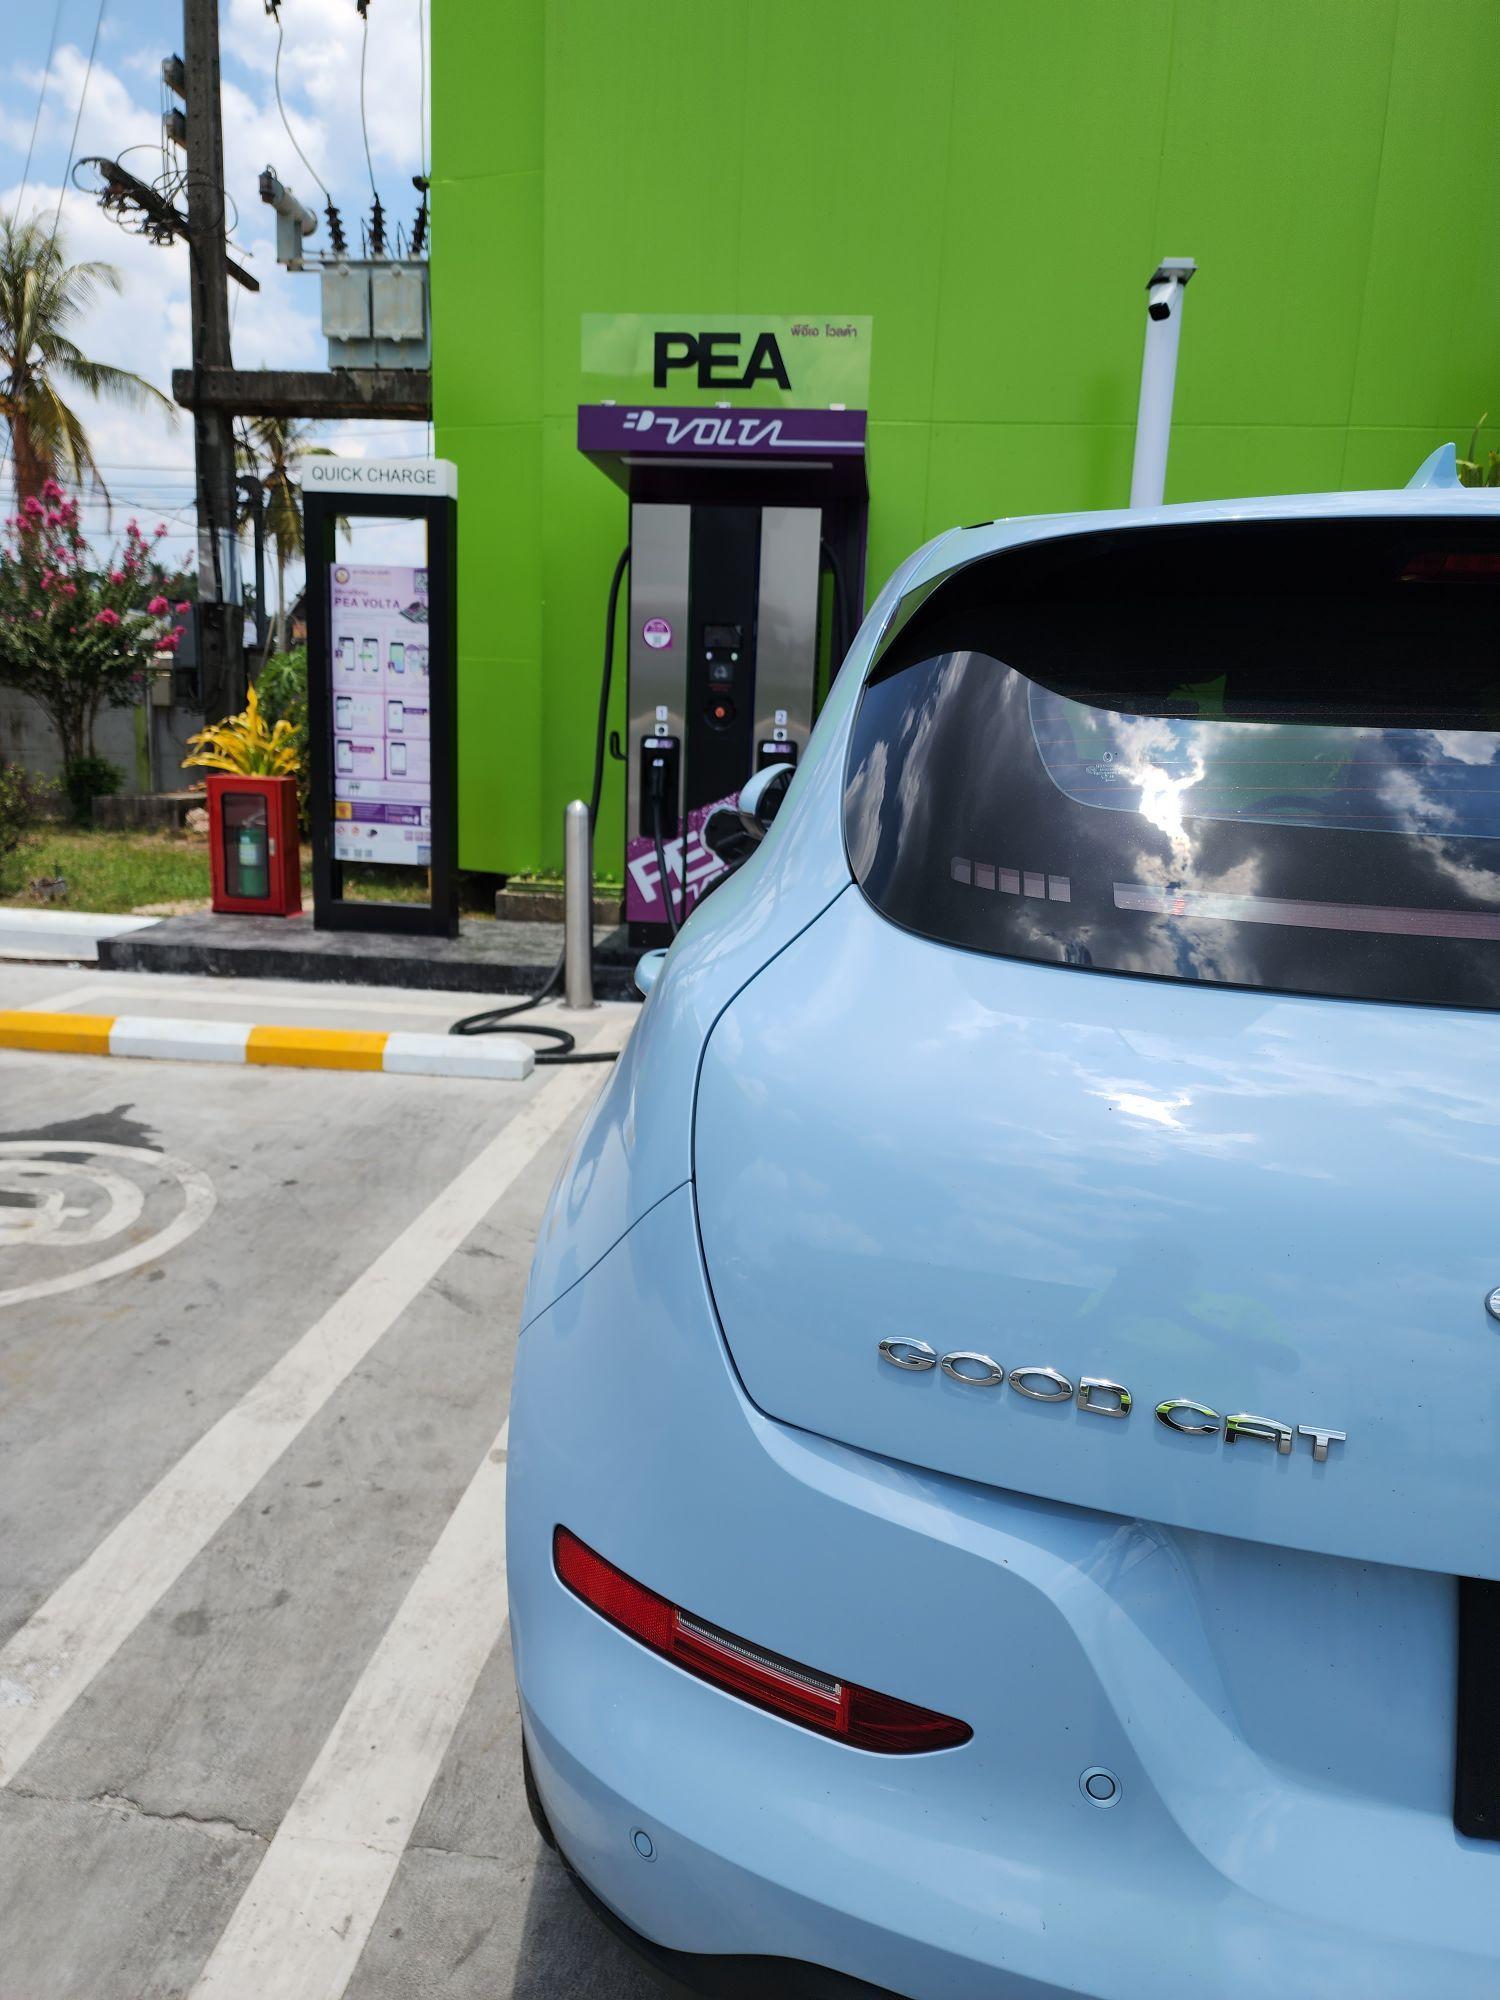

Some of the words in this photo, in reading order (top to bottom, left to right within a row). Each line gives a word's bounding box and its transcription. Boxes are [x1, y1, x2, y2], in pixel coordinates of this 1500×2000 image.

[654, 332, 791, 390] PEA
[655, 418, 865, 447] VOLTA
[312, 466, 362, 482] QUICK
[367, 468, 436, 484] CHARGE
[335, 597, 358, 608] PEA
[363, 598, 400, 609] VOLTA
[878, 1336, 1132, 1418] GOOD
[1154, 1398, 1346, 1462] CAT
